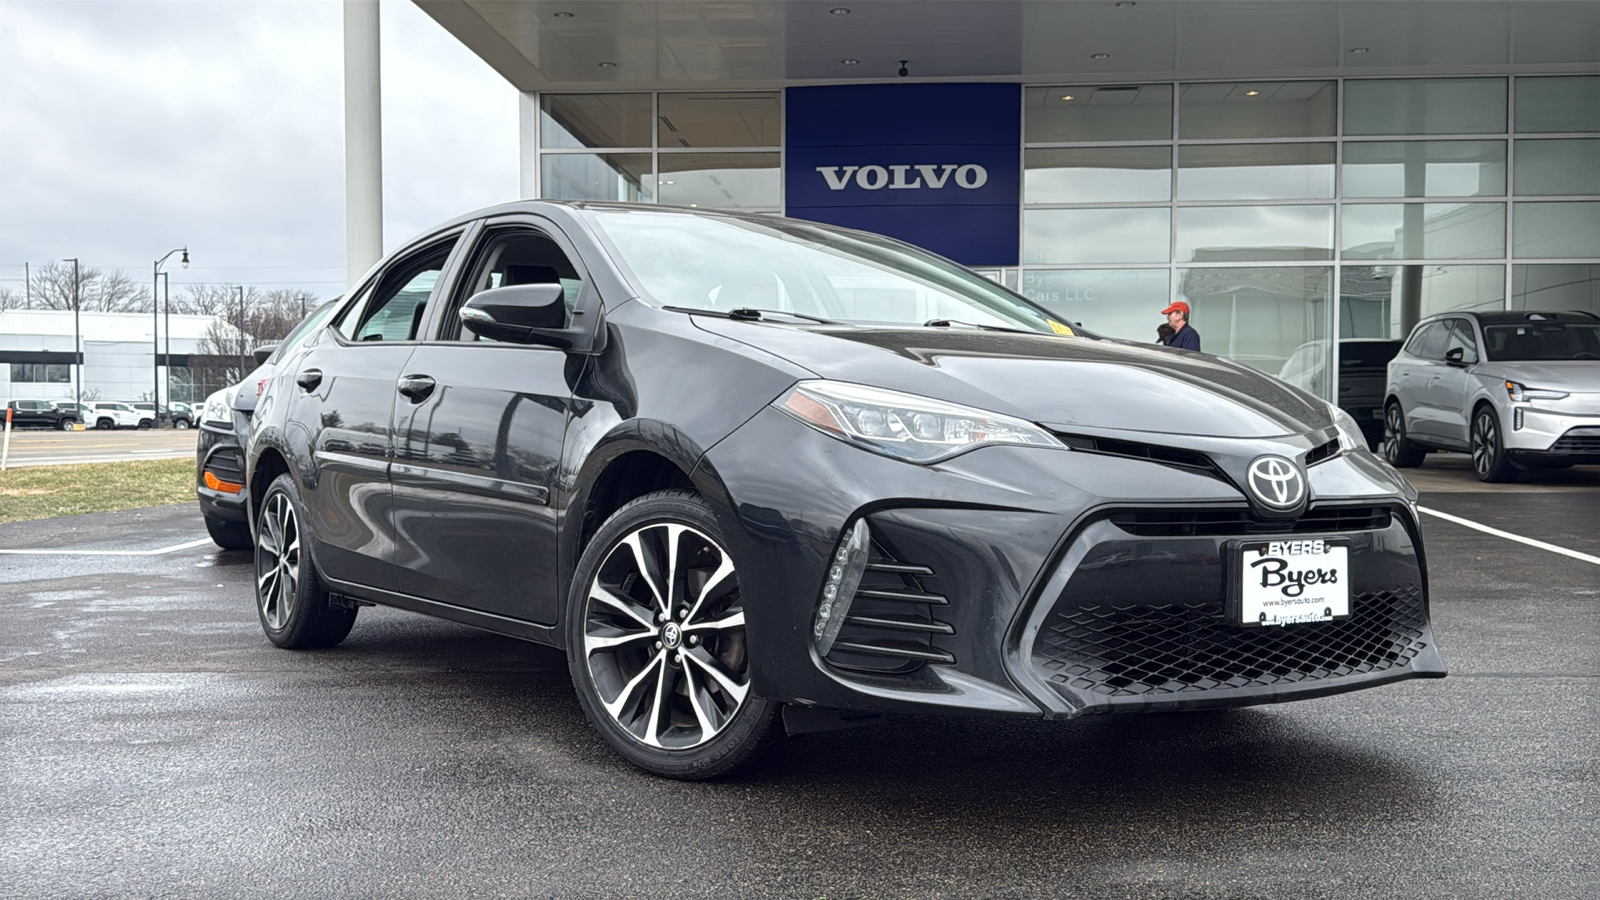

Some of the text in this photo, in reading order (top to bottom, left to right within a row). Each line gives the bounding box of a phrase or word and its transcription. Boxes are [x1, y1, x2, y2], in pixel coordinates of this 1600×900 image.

[816, 164, 988, 190] VOLVO
[1025, 272, 1063, 287] Byer
[1025, 288, 1094, 301] Cars LLC
[1267, 540, 1324, 555] BYERS
[1250, 557, 1338, 597] Byers
[1262, 597, 1325, 608] www.byersauto.com
[1261, 612, 1333, 627] byersauto
